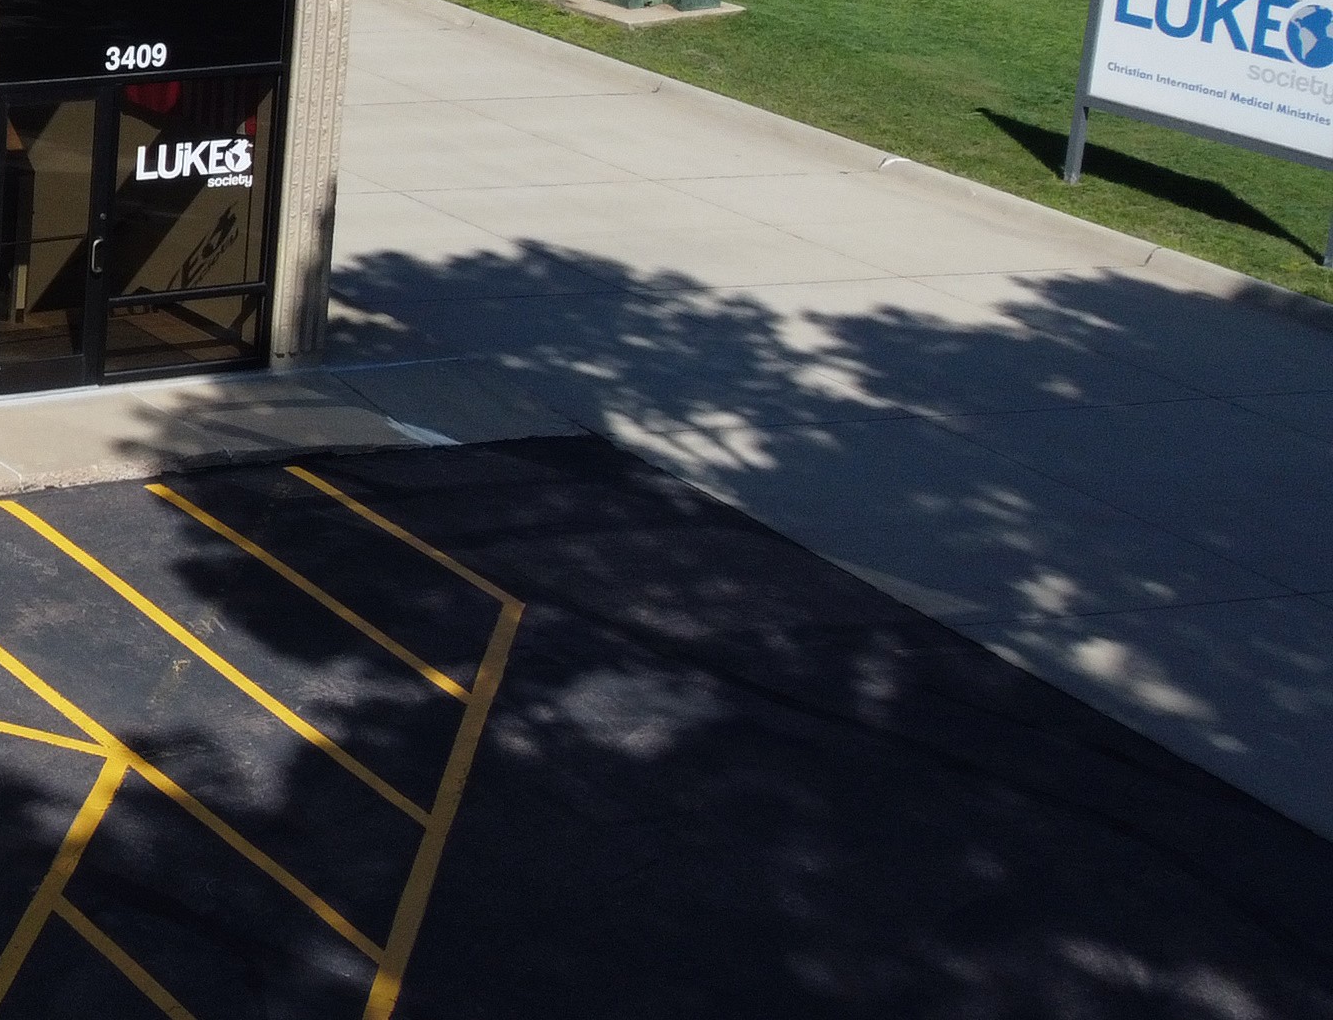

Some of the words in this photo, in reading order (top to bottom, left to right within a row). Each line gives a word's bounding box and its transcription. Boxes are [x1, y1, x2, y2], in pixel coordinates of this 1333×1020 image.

[105, 43, 167, 71] 3409
[1107, 61, 1154, 81] Christian
[1156, 73, 1227, 99] International
[1230, 92, 1274, 111] Medical
[1277, 104, 1331, 126] Ministries
[1247, 65, 1333, 105] society
[207, 173, 253, 188] society
